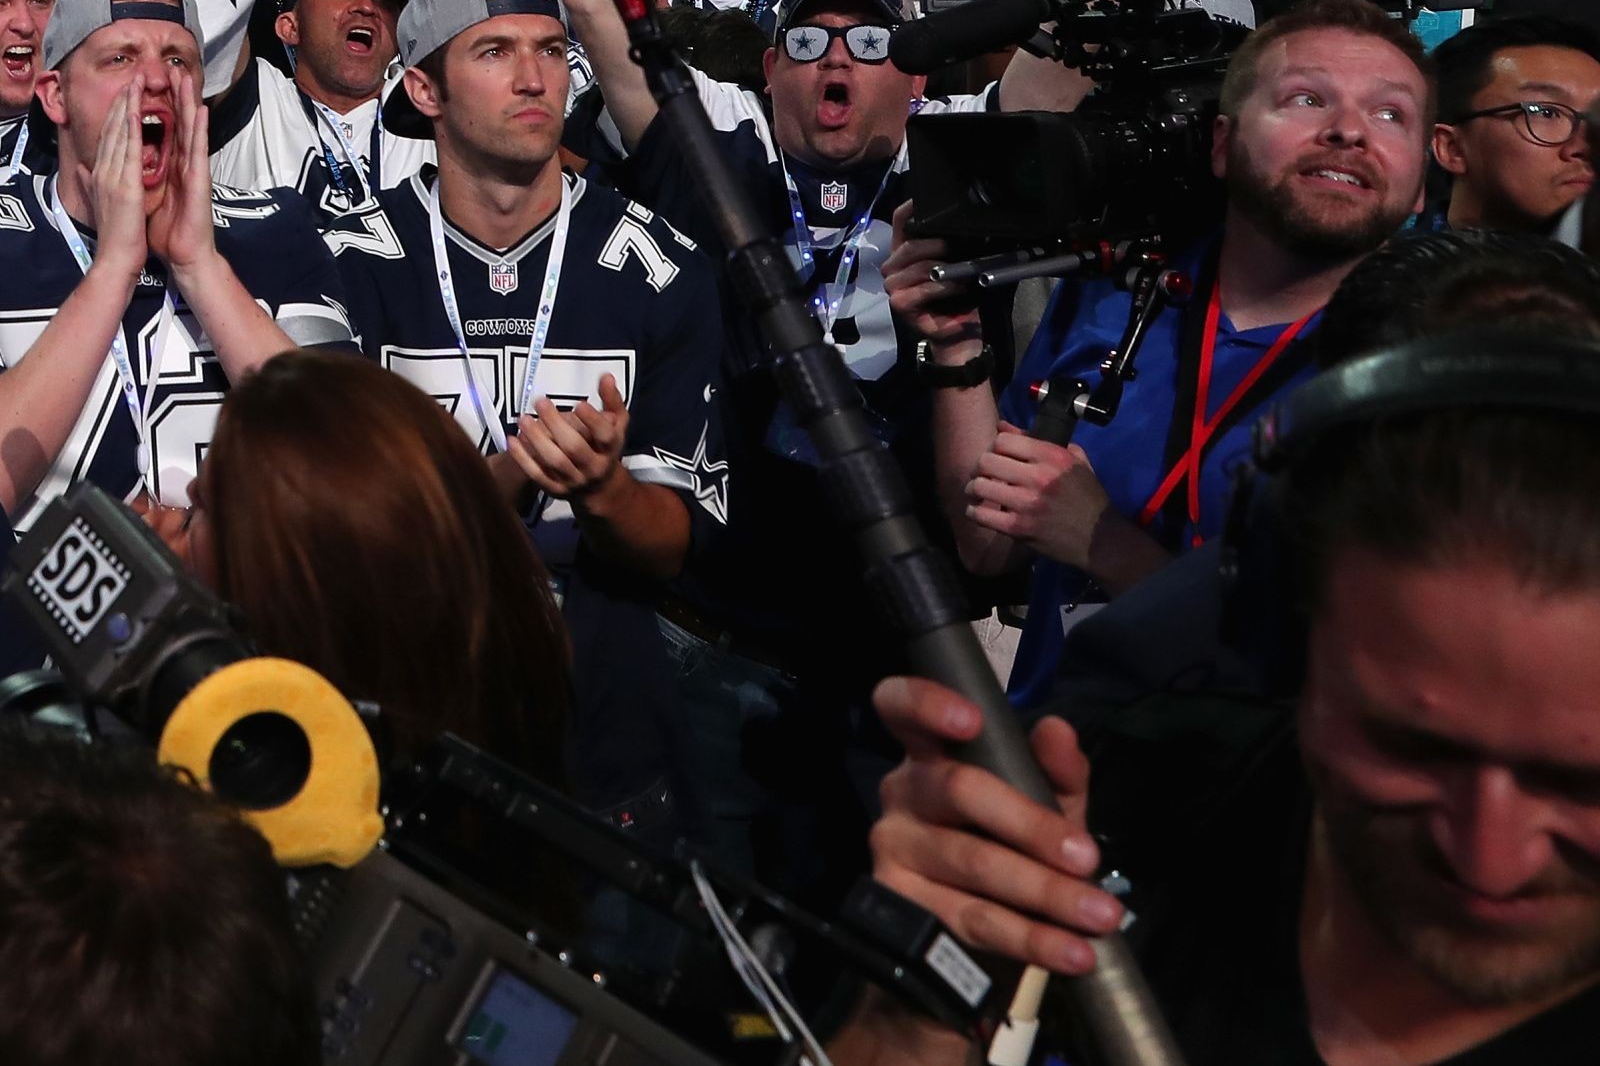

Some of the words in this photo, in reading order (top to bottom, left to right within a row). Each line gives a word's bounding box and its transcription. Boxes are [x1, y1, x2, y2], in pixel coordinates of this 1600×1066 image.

[825, 194, 844, 206] NFL
[494, 274, 514, 289] NFL
[465, 318, 537, 336] COWOYS
[40, 532, 119, 618] SDS
